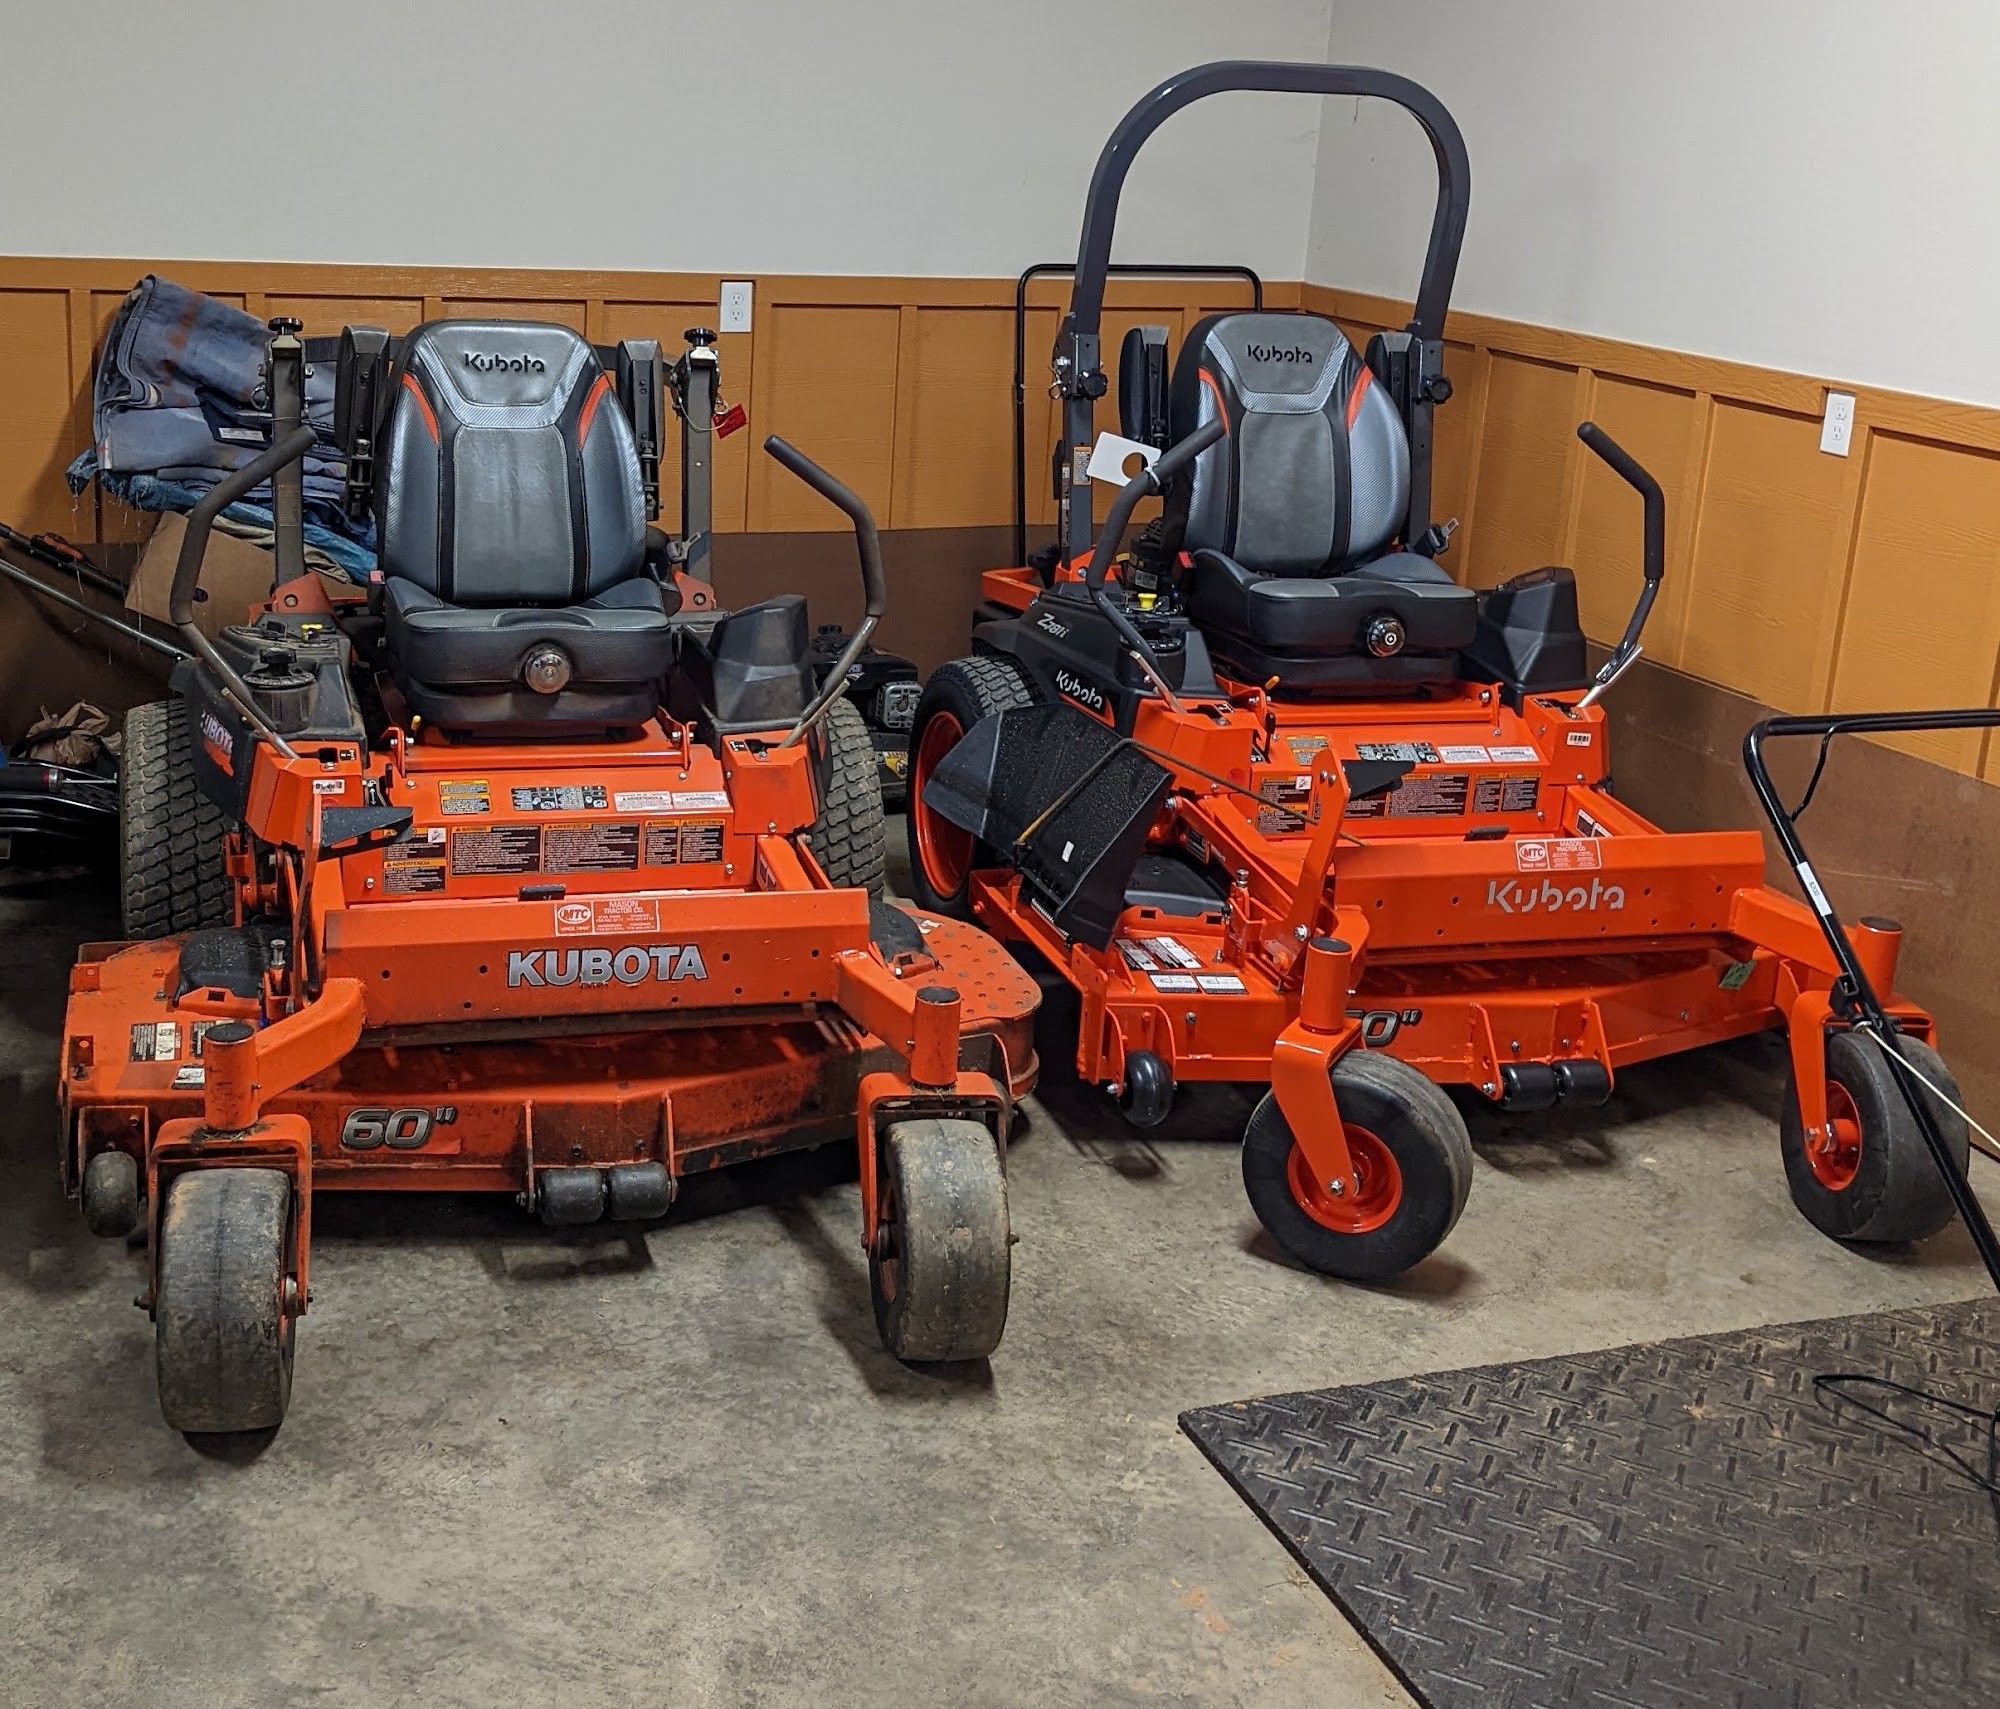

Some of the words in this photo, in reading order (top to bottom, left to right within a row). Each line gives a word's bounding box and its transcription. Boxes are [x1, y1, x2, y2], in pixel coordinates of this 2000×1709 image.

[465, 353, 545, 372] Kubota
[1247, 344, 1313, 363] Kubota
[1055, 669, 1104, 710] Kubota
[608, 900, 639, 908] MASON
[1487, 877, 1625, 914] Kubota
[562, 908, 589, 920] MTC
[603, 907, 631, 915] TRACTOR
[507, 944, 709, 989] KUBOTA
[1344, 1009, 1421, 1047] 0"
